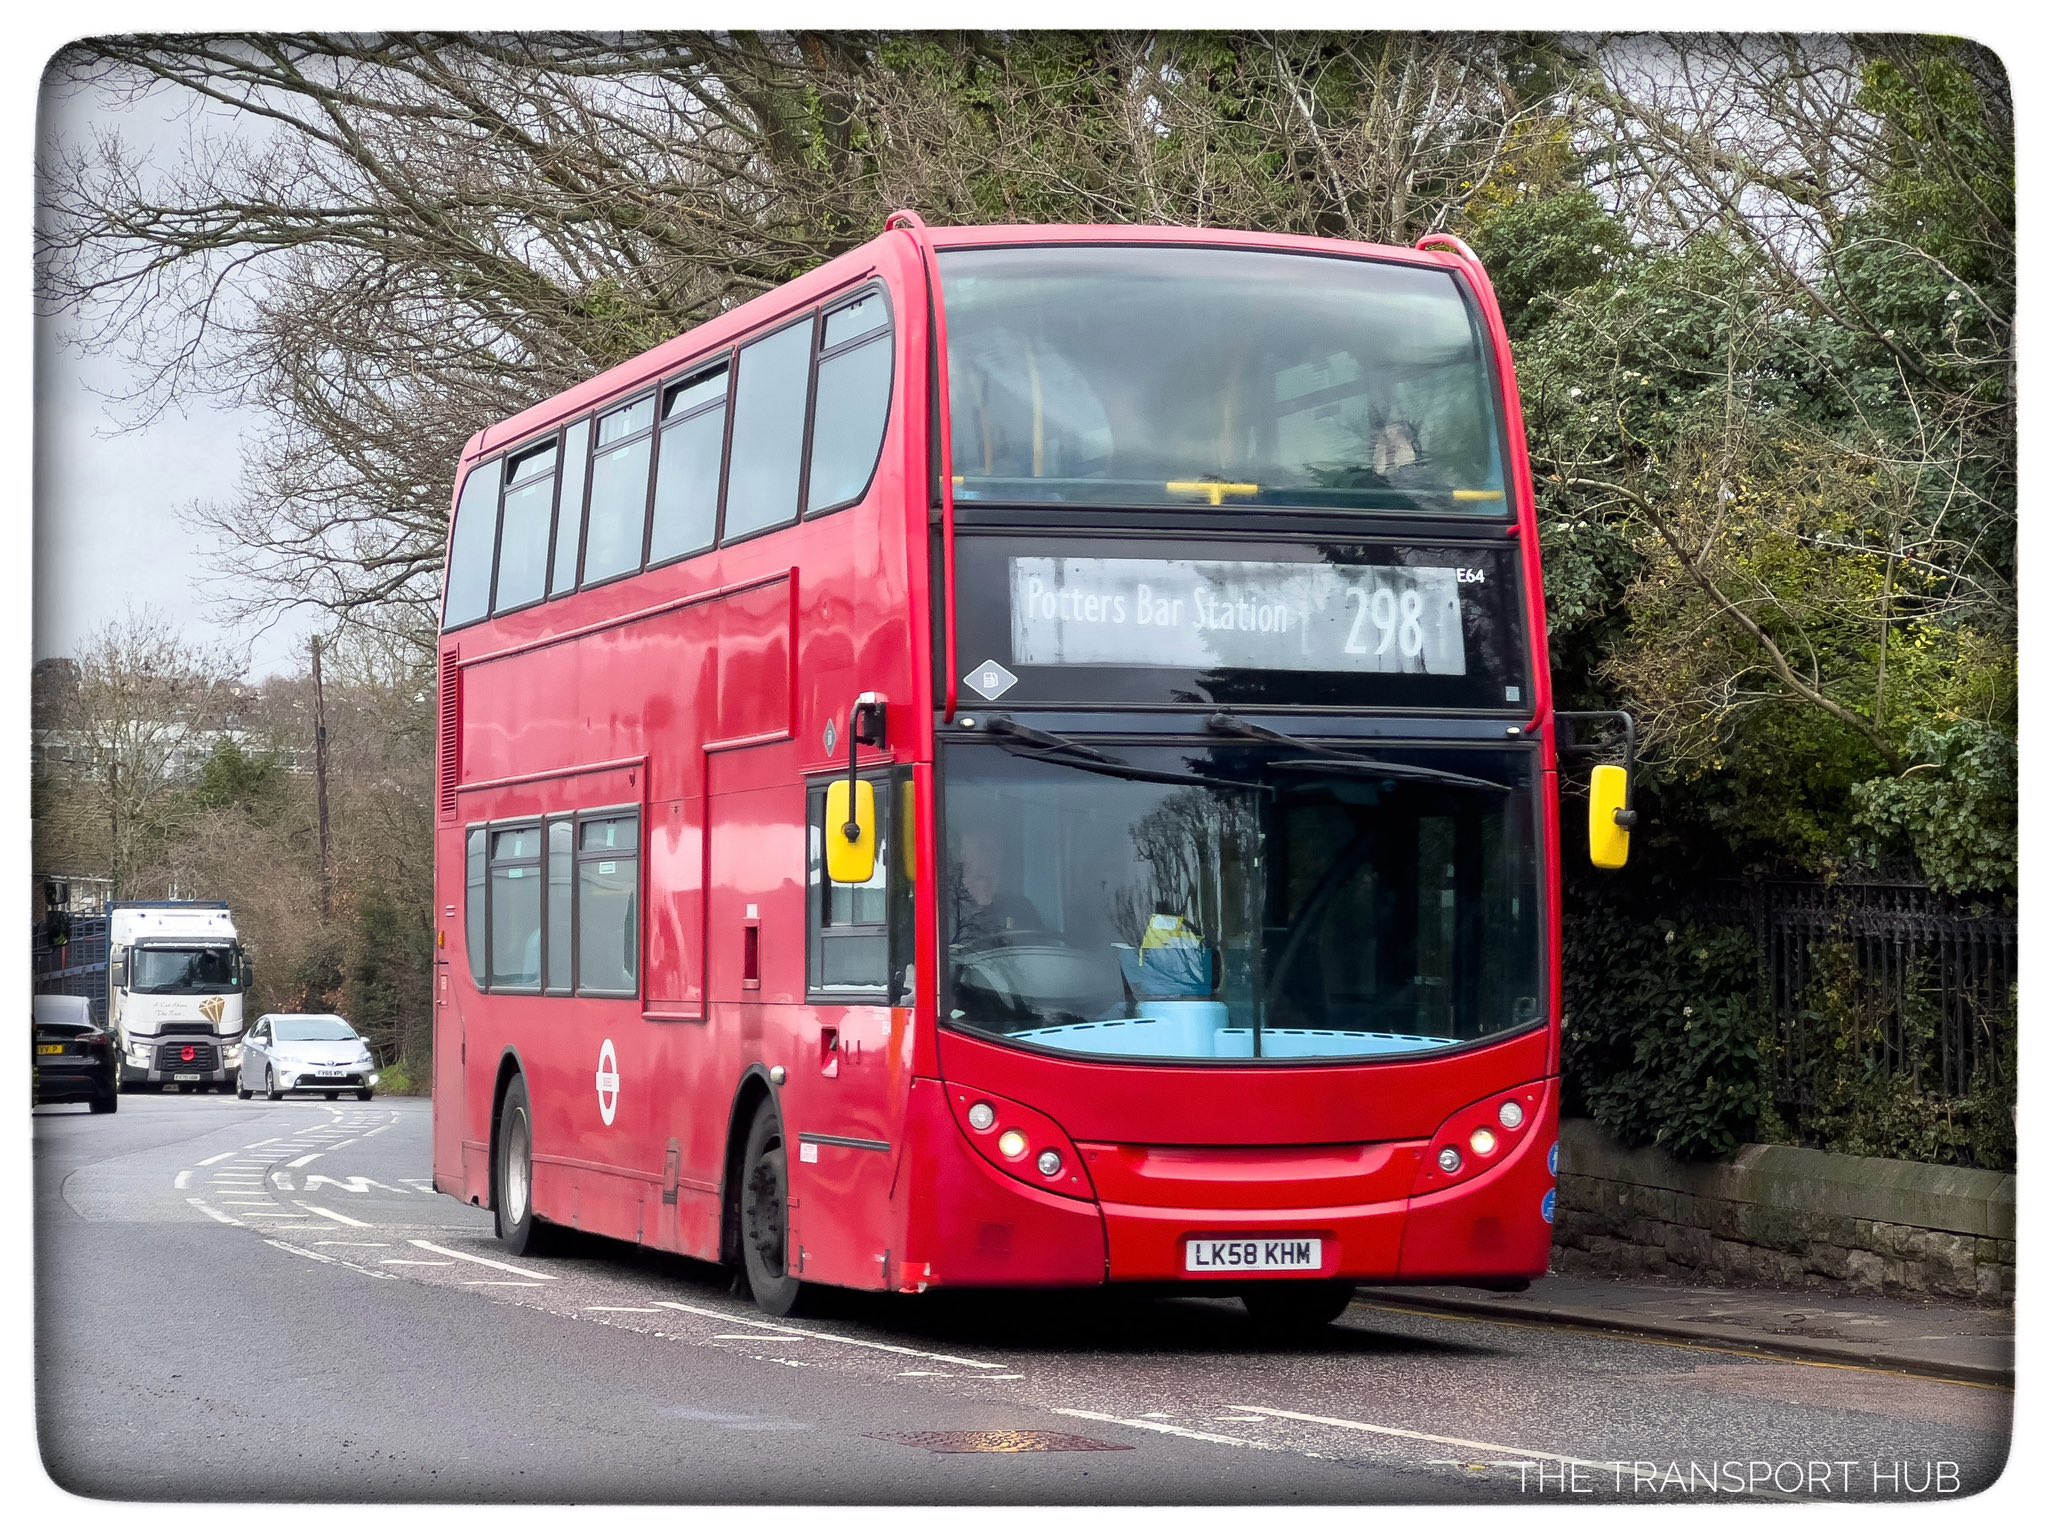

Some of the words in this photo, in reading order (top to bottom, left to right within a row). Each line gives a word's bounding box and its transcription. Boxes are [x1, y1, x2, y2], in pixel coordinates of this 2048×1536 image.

[1456, 568, 1486, 584] E64
[1028, 576, 1127, 624] Potters
[1136, 583, 1184, 627] Bar
[1192, 586, 1289, 633] Station
[1344, 586, 1423, 657] 298
[1196, 1243, 1258, 1266] LK58
[1265, 1242, 1311, 1265] KHM
